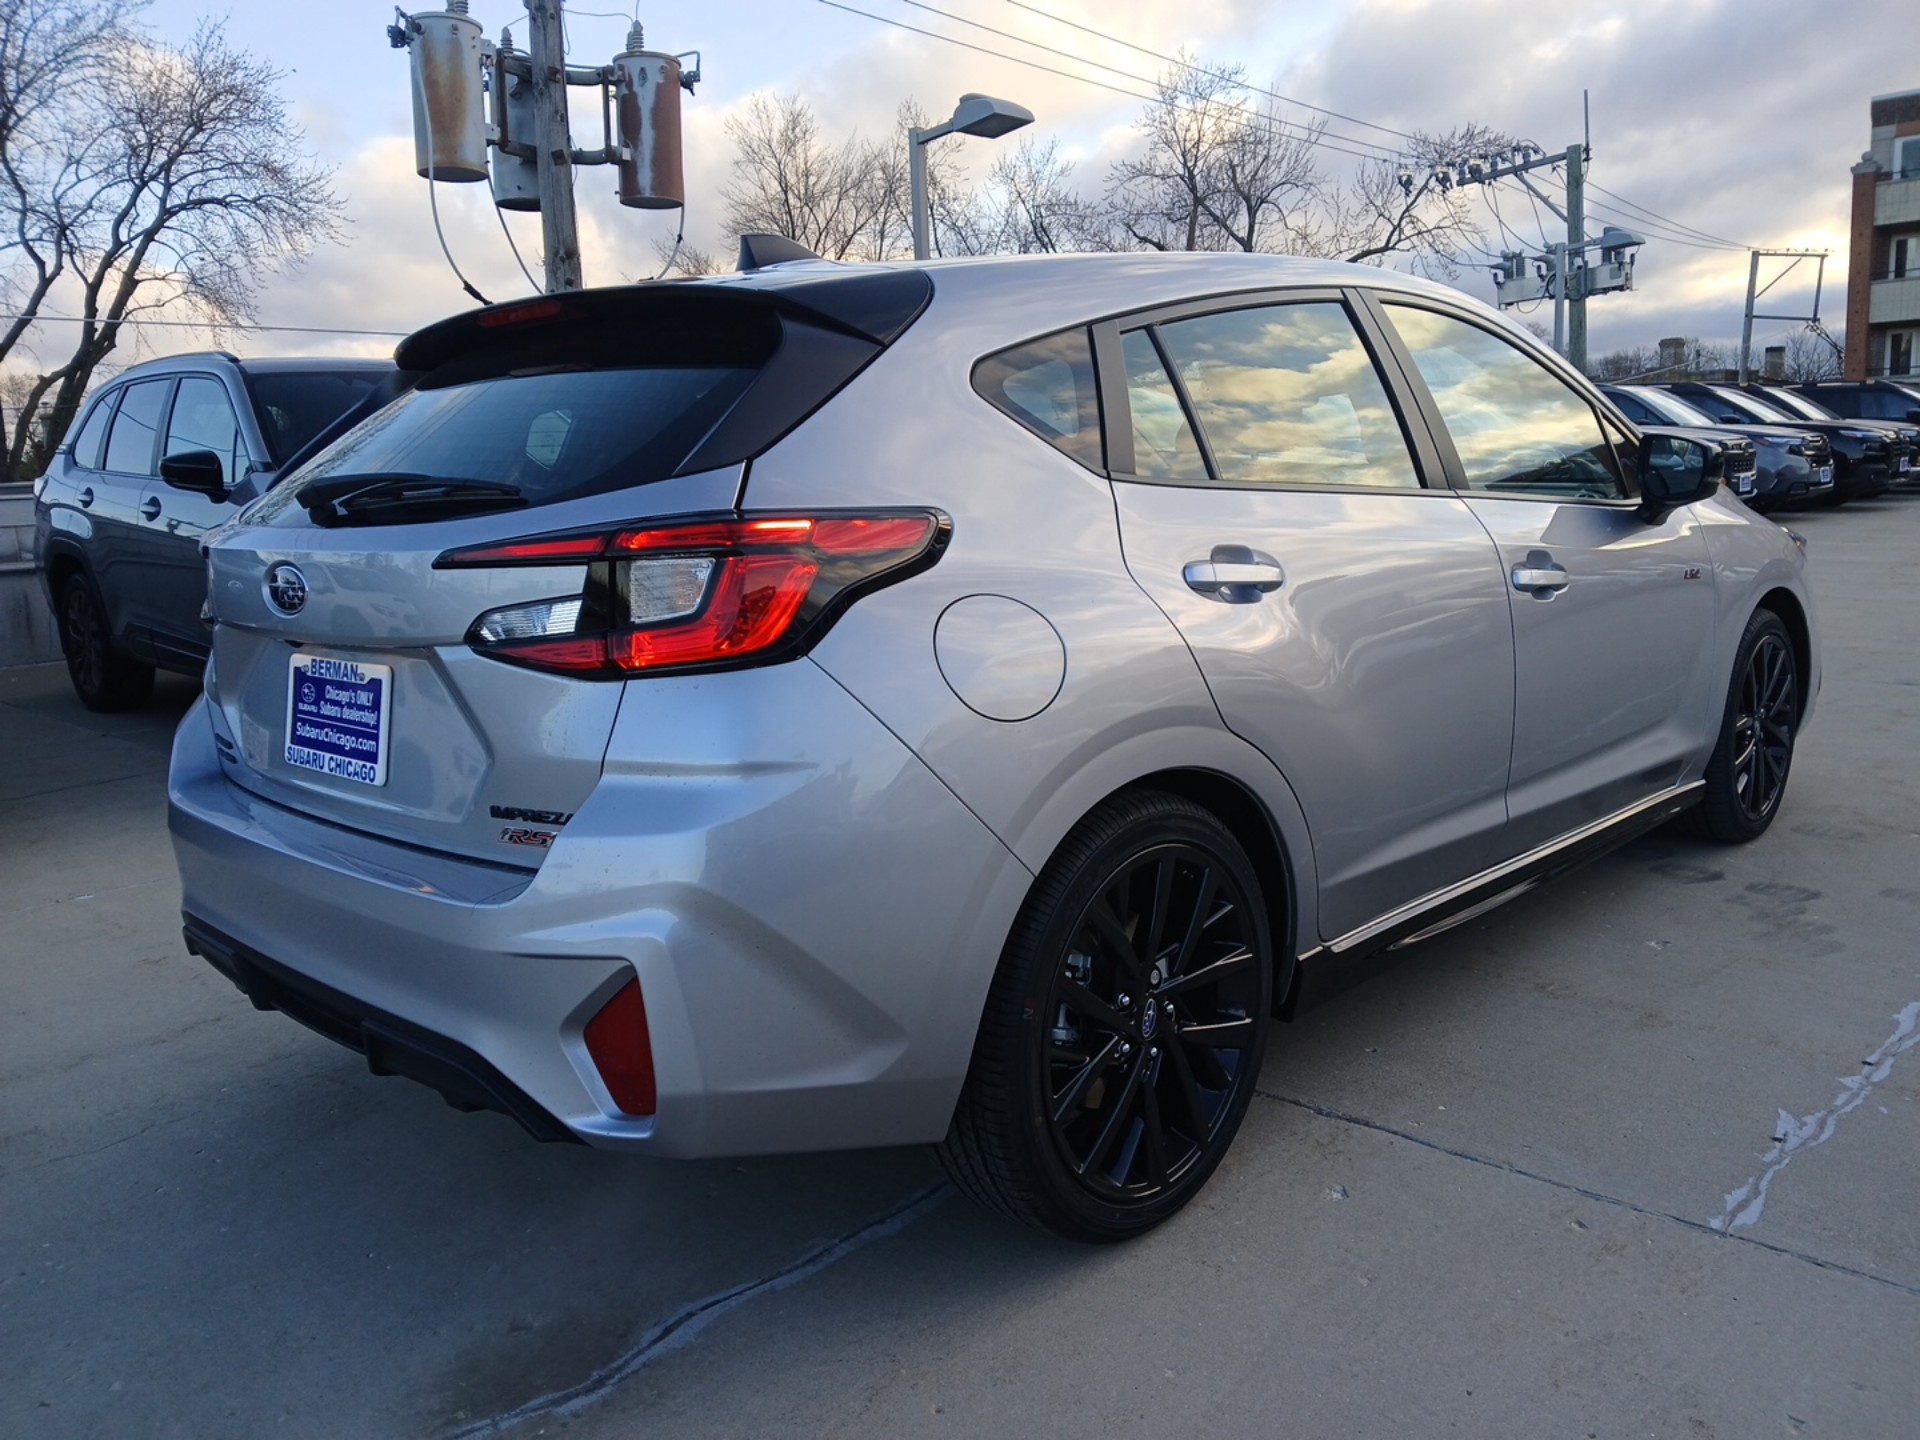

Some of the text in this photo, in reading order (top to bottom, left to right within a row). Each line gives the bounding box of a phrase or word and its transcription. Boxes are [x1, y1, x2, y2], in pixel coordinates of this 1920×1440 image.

[311, 658, 358, 681] BERMAN
[325, 684, 374, 706] Chicago's ONLY
[320, 700, 378, 727] Subaru dealership!
[296, 722, 377, 752] SubaruChicago.com
[287, 746, 376, 783] SUBARU CHICAGO
